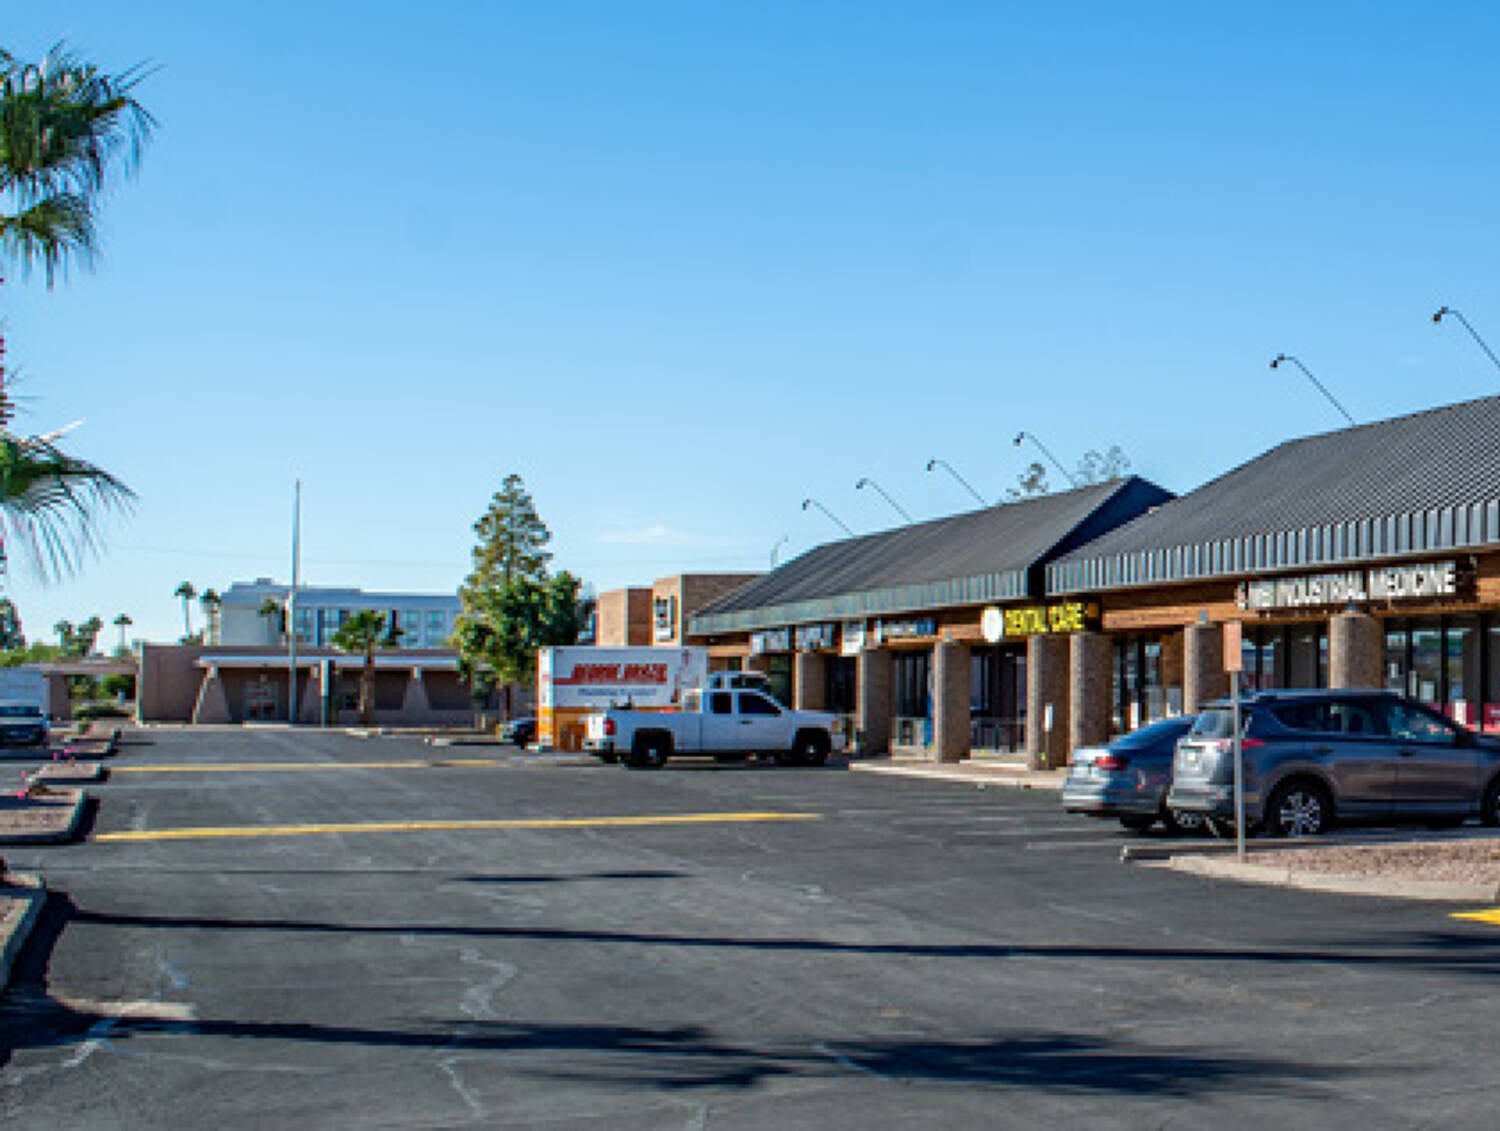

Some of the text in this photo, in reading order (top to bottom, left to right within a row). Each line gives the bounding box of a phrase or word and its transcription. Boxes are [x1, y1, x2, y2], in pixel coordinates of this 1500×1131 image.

[1276, 570, 1367, 607] INDUSTRIAL
[1369, 561, 1456, 599] MEDICINE
[1004, 602, 1083, 635] DENTAL CARE
